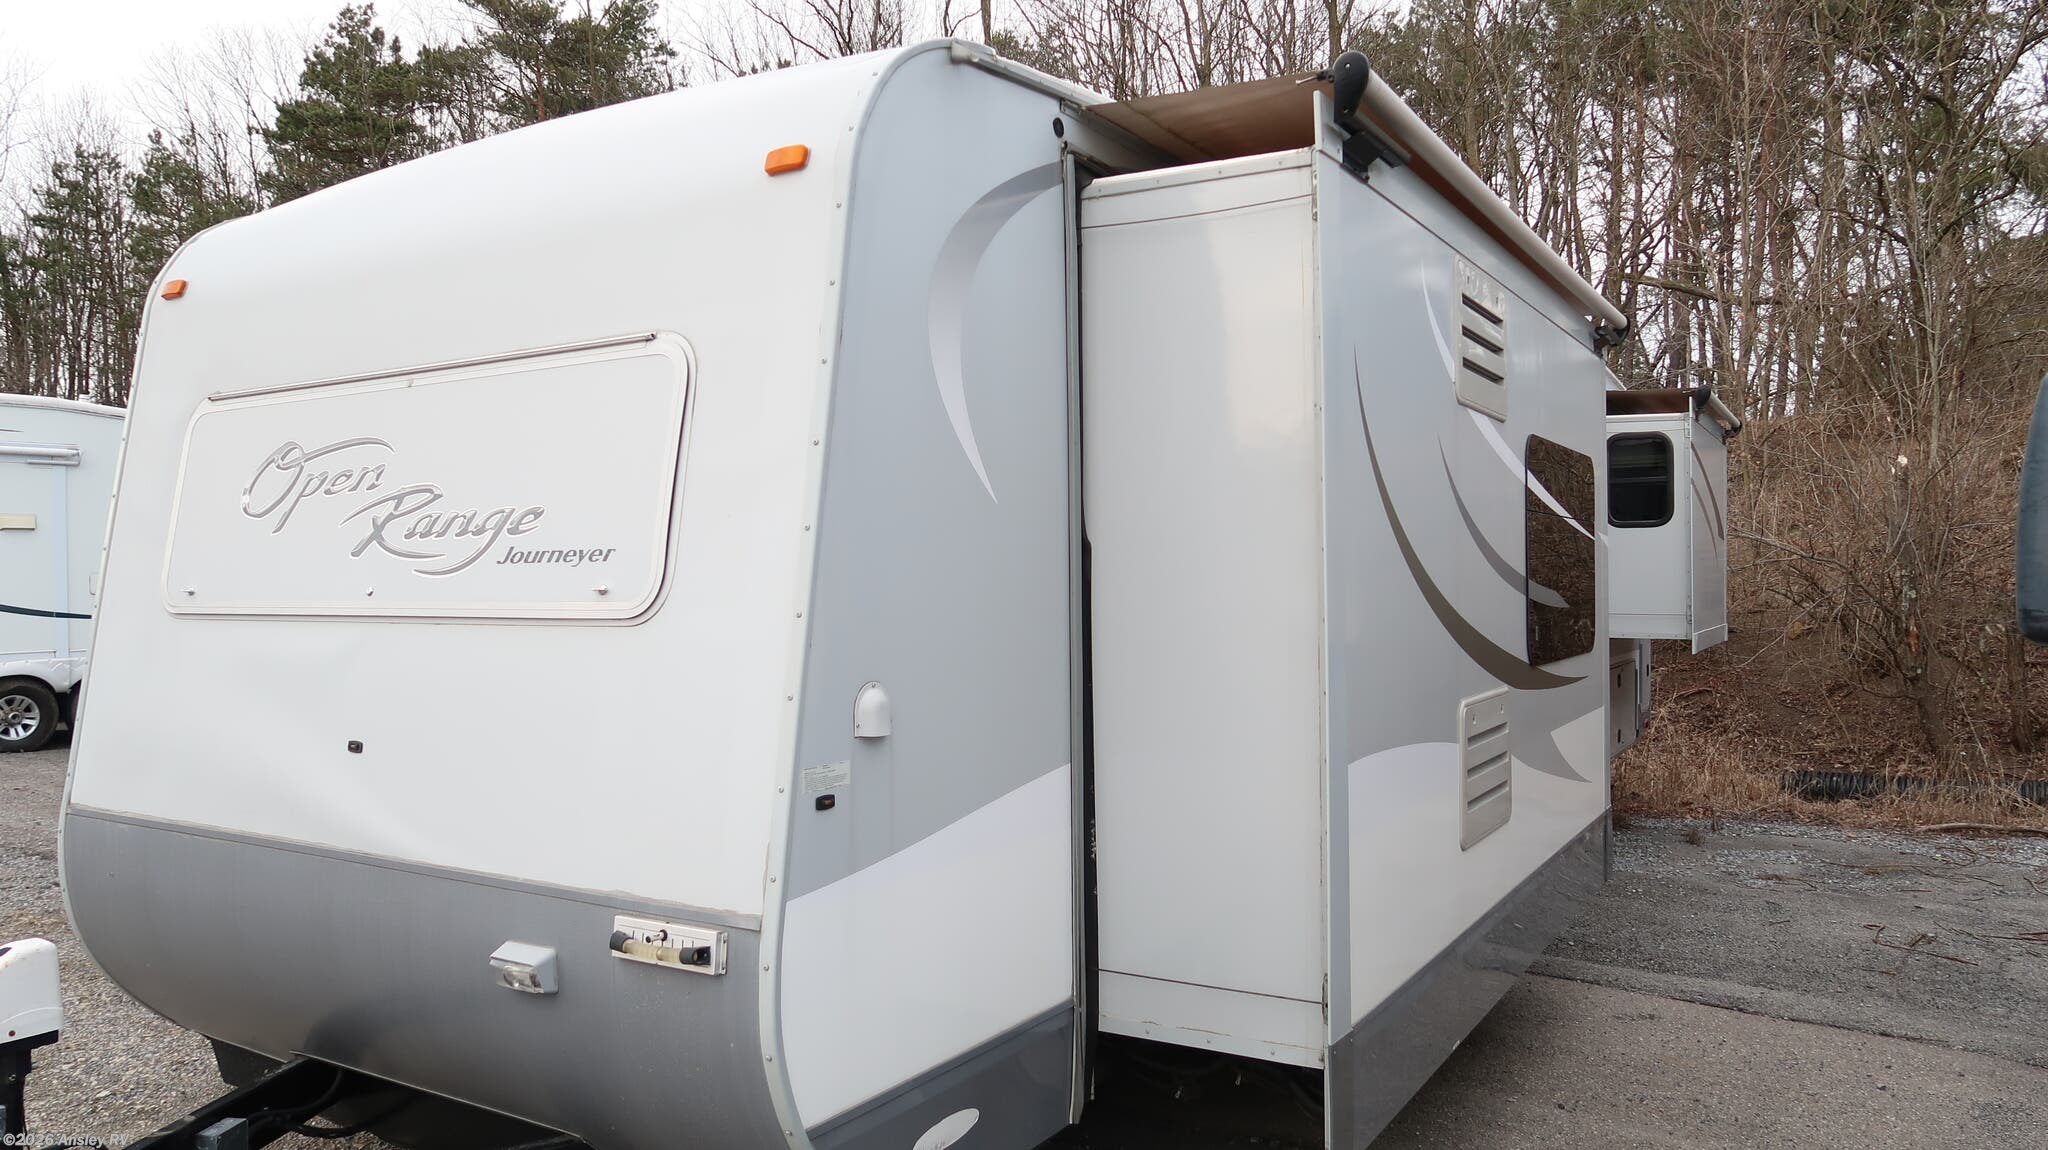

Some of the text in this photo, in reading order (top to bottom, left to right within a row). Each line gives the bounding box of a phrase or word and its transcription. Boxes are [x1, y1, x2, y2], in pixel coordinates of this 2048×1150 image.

[241, 437, 545, 576] Open Range
[496, 545, 616, 567] Journeyer
